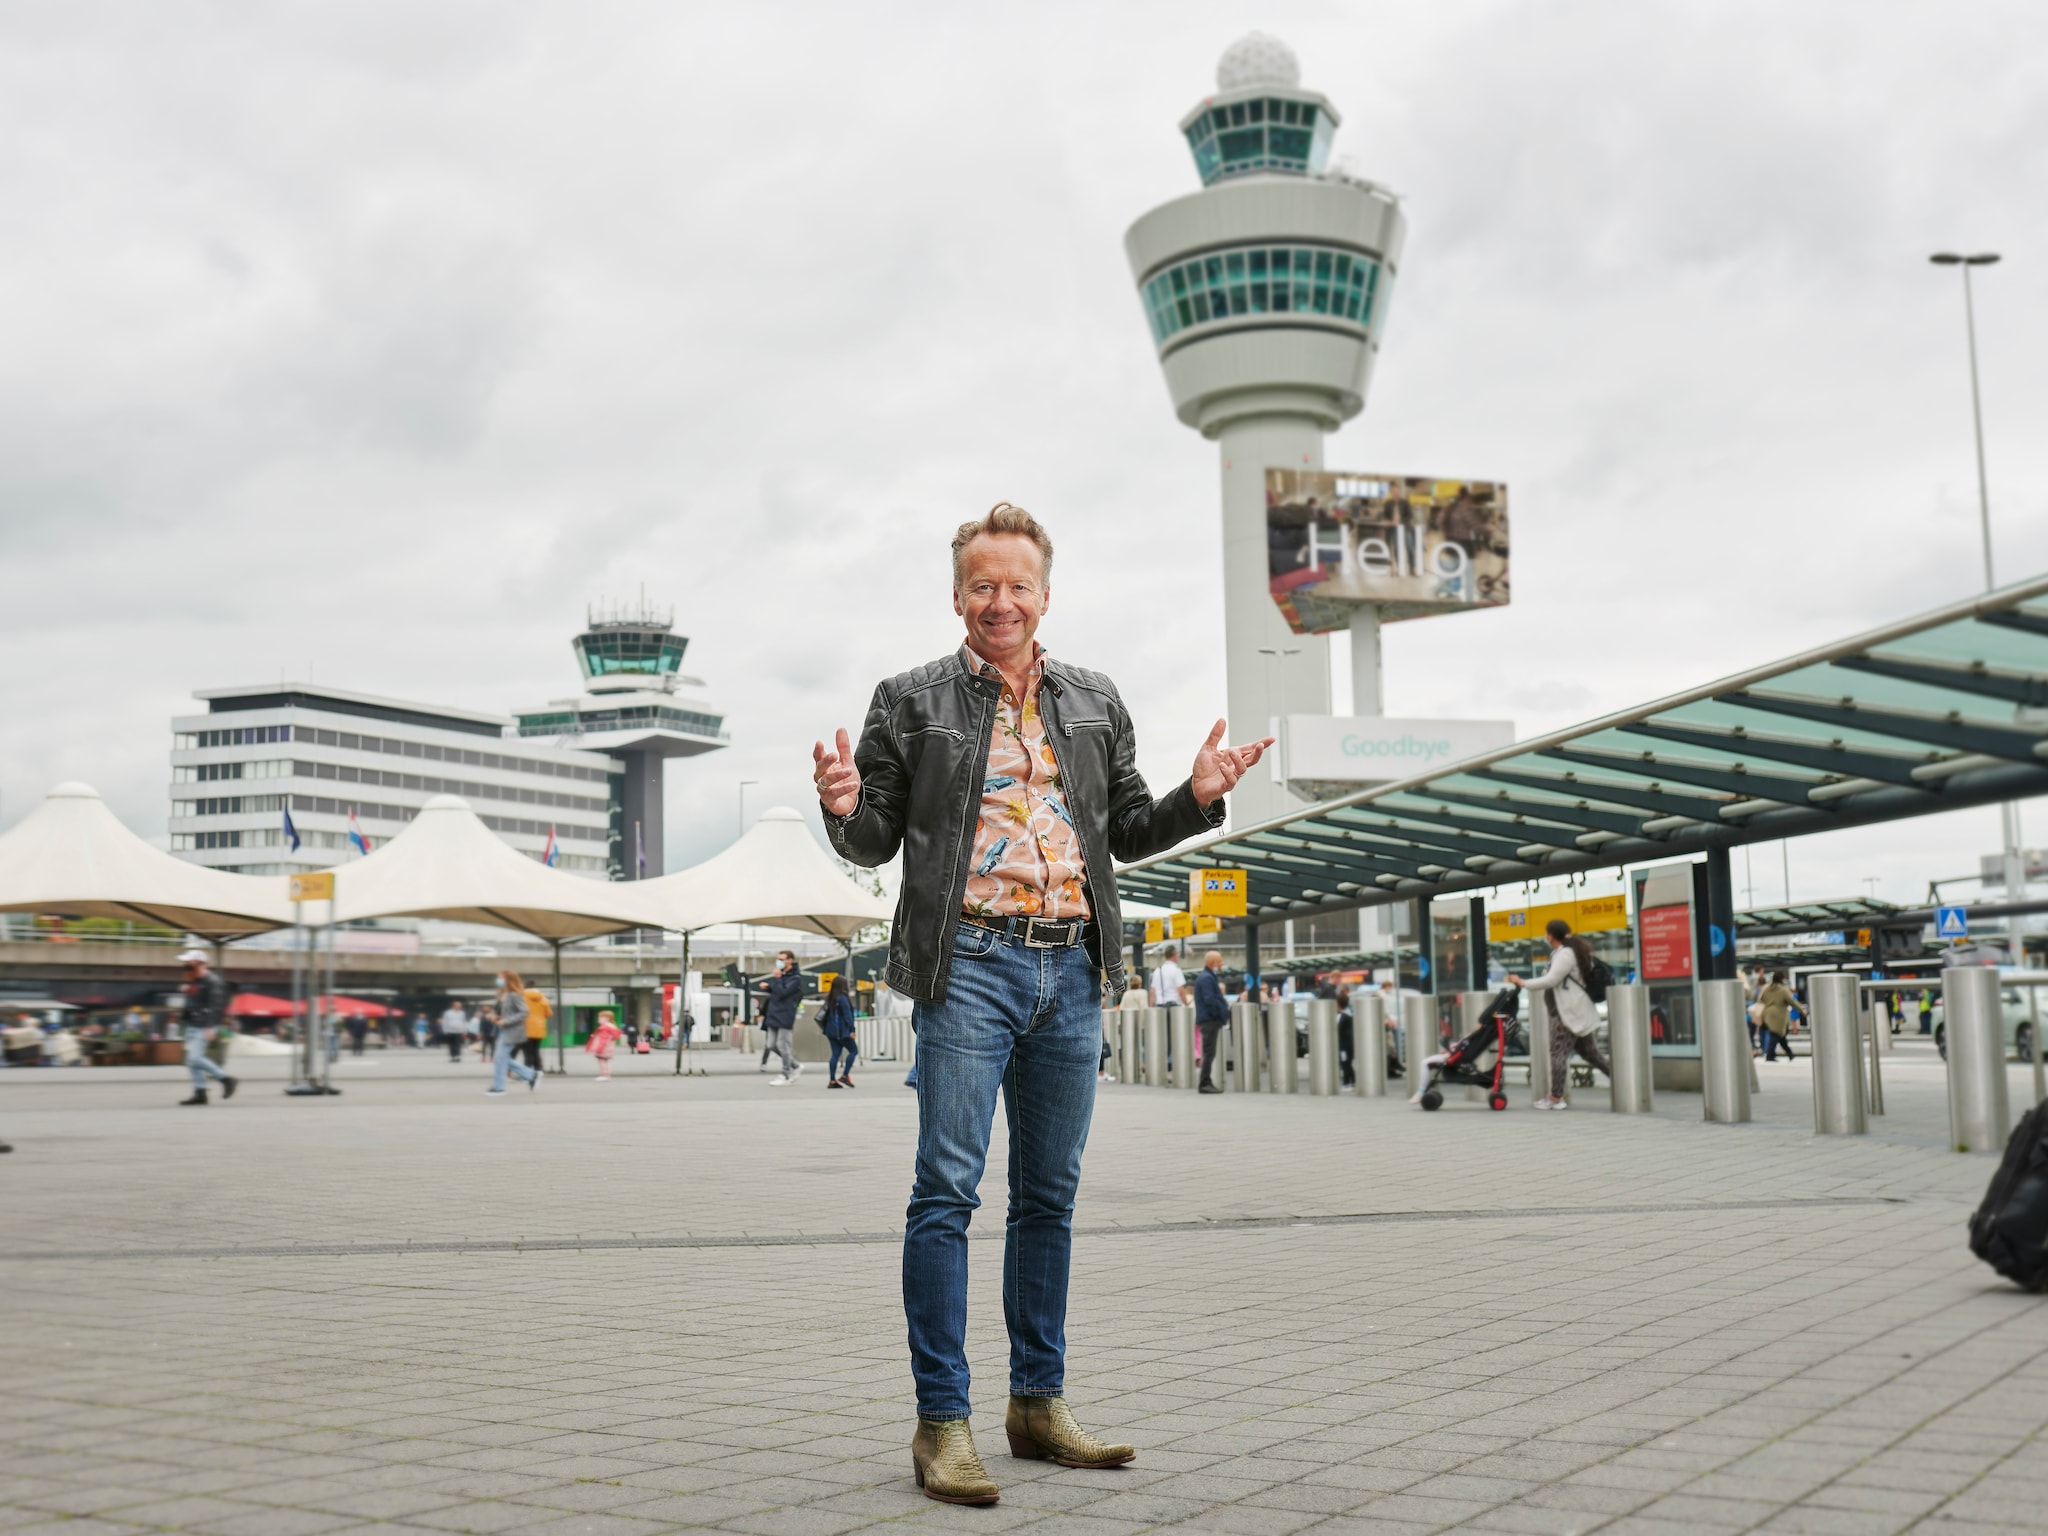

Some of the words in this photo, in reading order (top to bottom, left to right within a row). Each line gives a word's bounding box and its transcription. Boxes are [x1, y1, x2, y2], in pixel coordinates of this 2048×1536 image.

[1308, 521, 1468, 578] Hello
[1341, 733, 1449, 760] Goodbye
[1205, 871, 1234, 880] Parking
